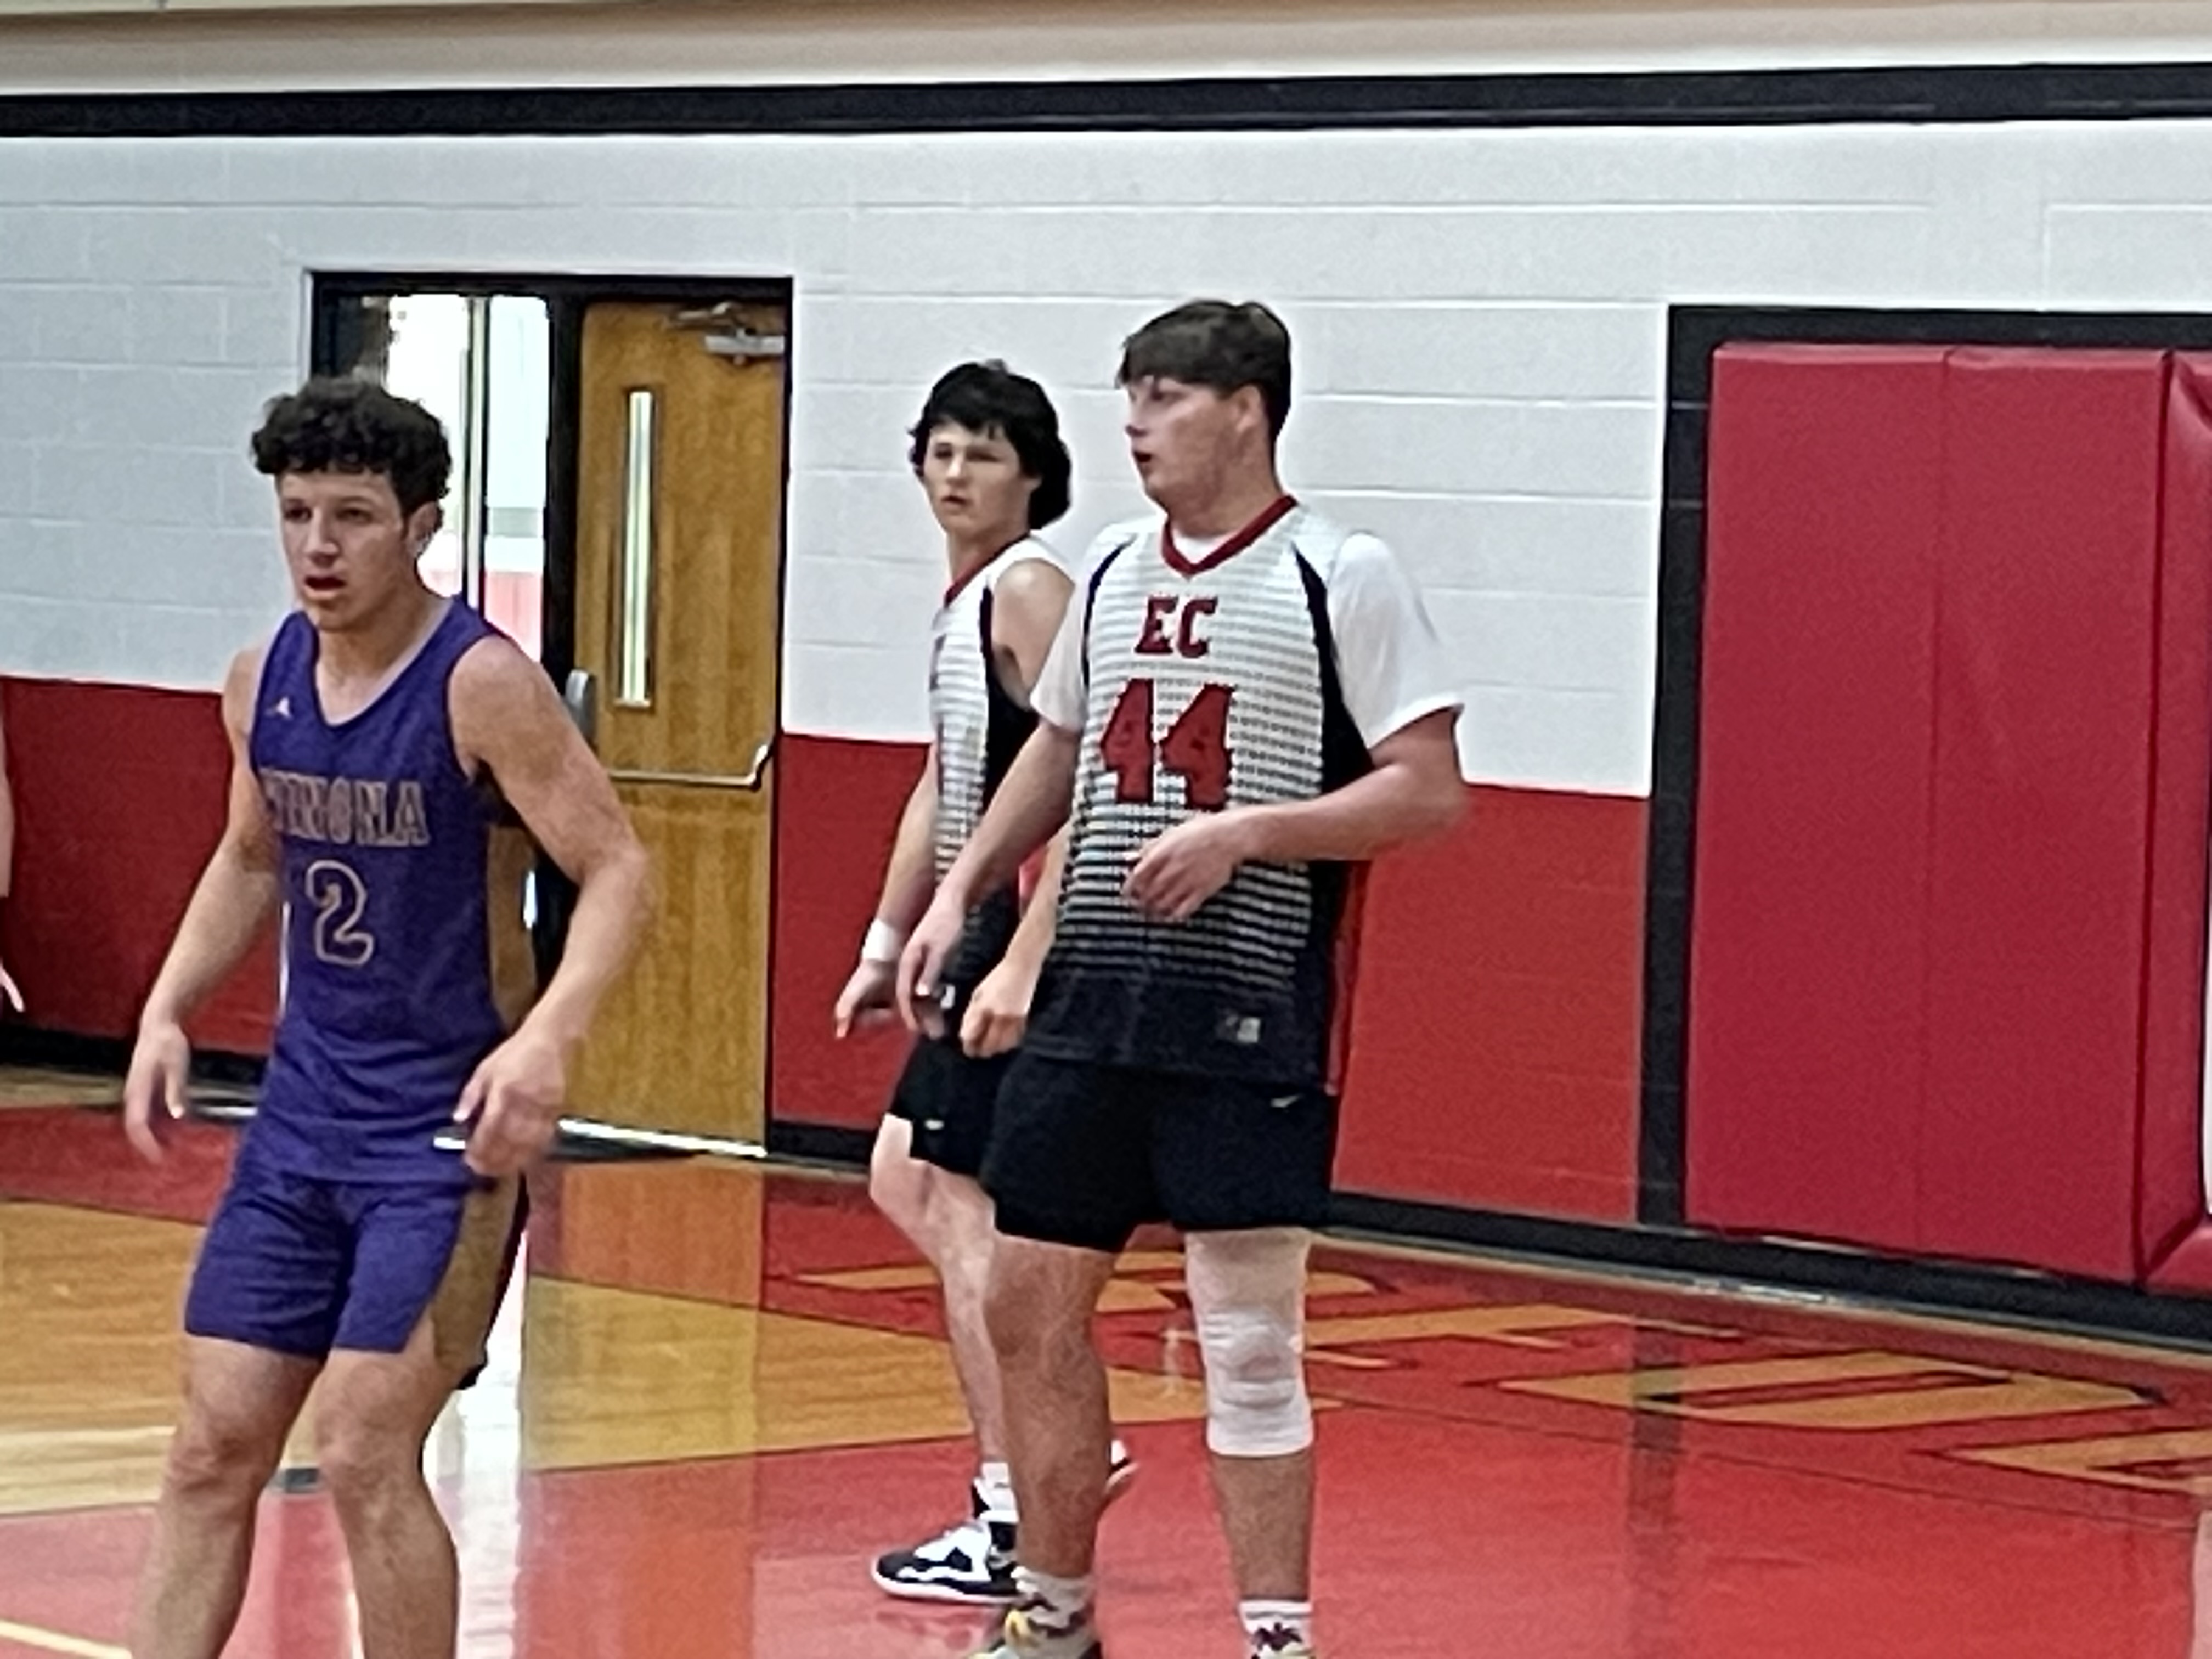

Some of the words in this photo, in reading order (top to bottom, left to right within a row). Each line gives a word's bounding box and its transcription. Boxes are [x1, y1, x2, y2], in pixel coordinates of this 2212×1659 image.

[1133, 595, 1218, 658] EC
[1099, 677, 1236, 812] 44
[305, 860, 375, 966] 2
